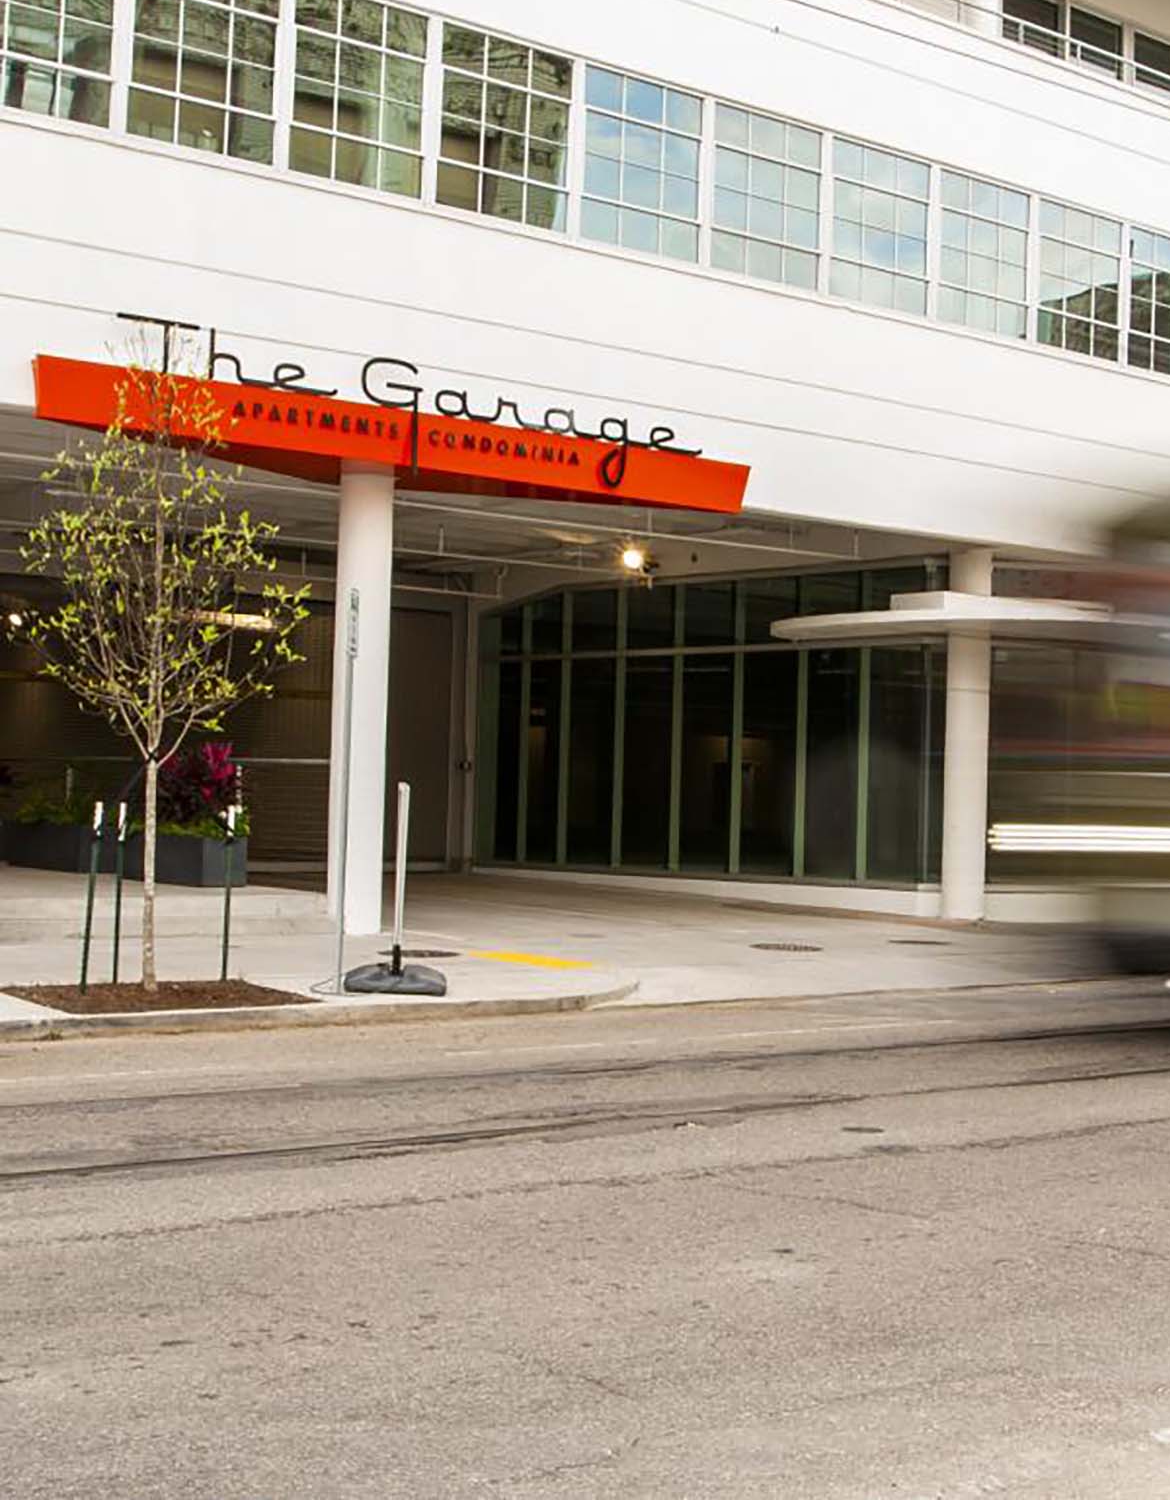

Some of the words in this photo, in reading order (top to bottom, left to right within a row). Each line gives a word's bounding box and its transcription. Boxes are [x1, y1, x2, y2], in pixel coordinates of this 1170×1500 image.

[116, 311, 338, 396] The
[361, 357, 703, 487] Garage
[231, 400, 399, 440] APARTMENTS
[428, 429, 580, 467] CONDOMINIA
